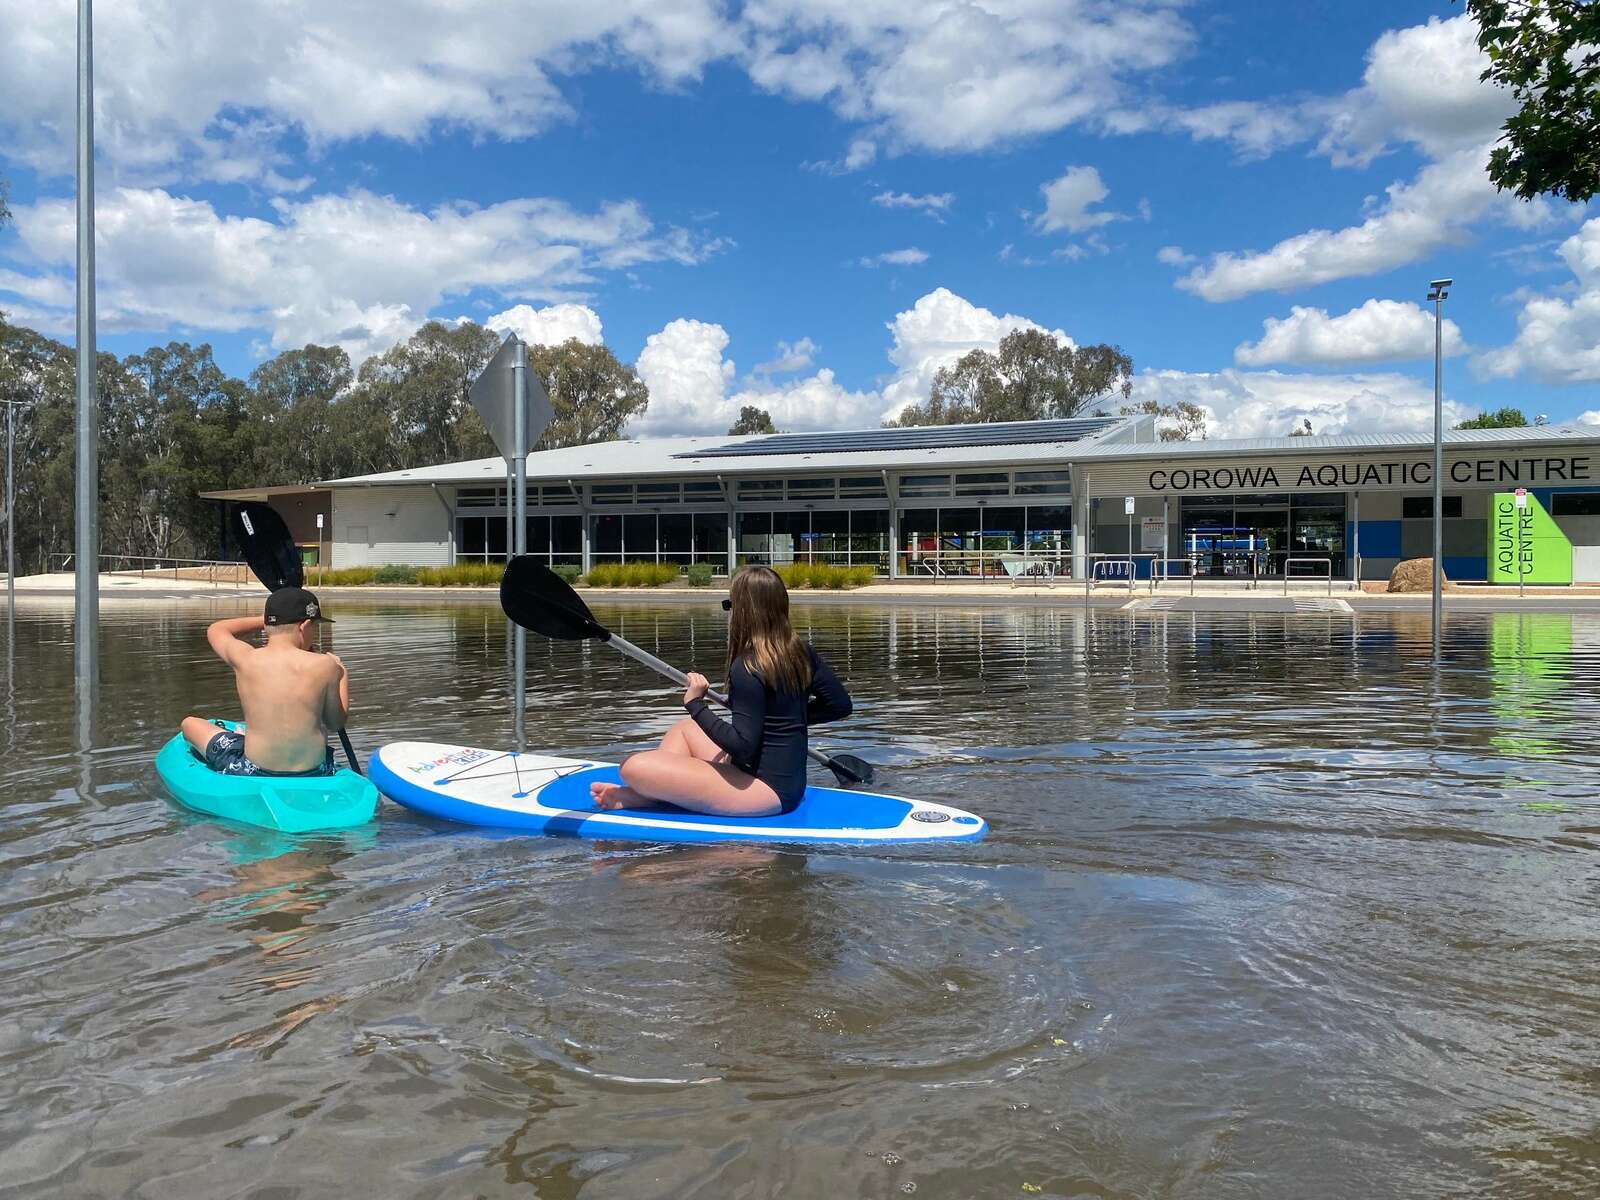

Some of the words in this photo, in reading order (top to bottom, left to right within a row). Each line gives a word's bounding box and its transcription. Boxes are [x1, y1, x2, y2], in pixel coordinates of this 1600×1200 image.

[1149, 467, 1280, 490] COROWA
[1296, 463, 1432, 487] AQUATIC
[1450, 457, 1590, 483] CENTRE
[1498, 502, 1513, 574] AQUATIC
[1518, 506, 1533, 575] CENTRE
[407, 748, 475, 774] Advere
